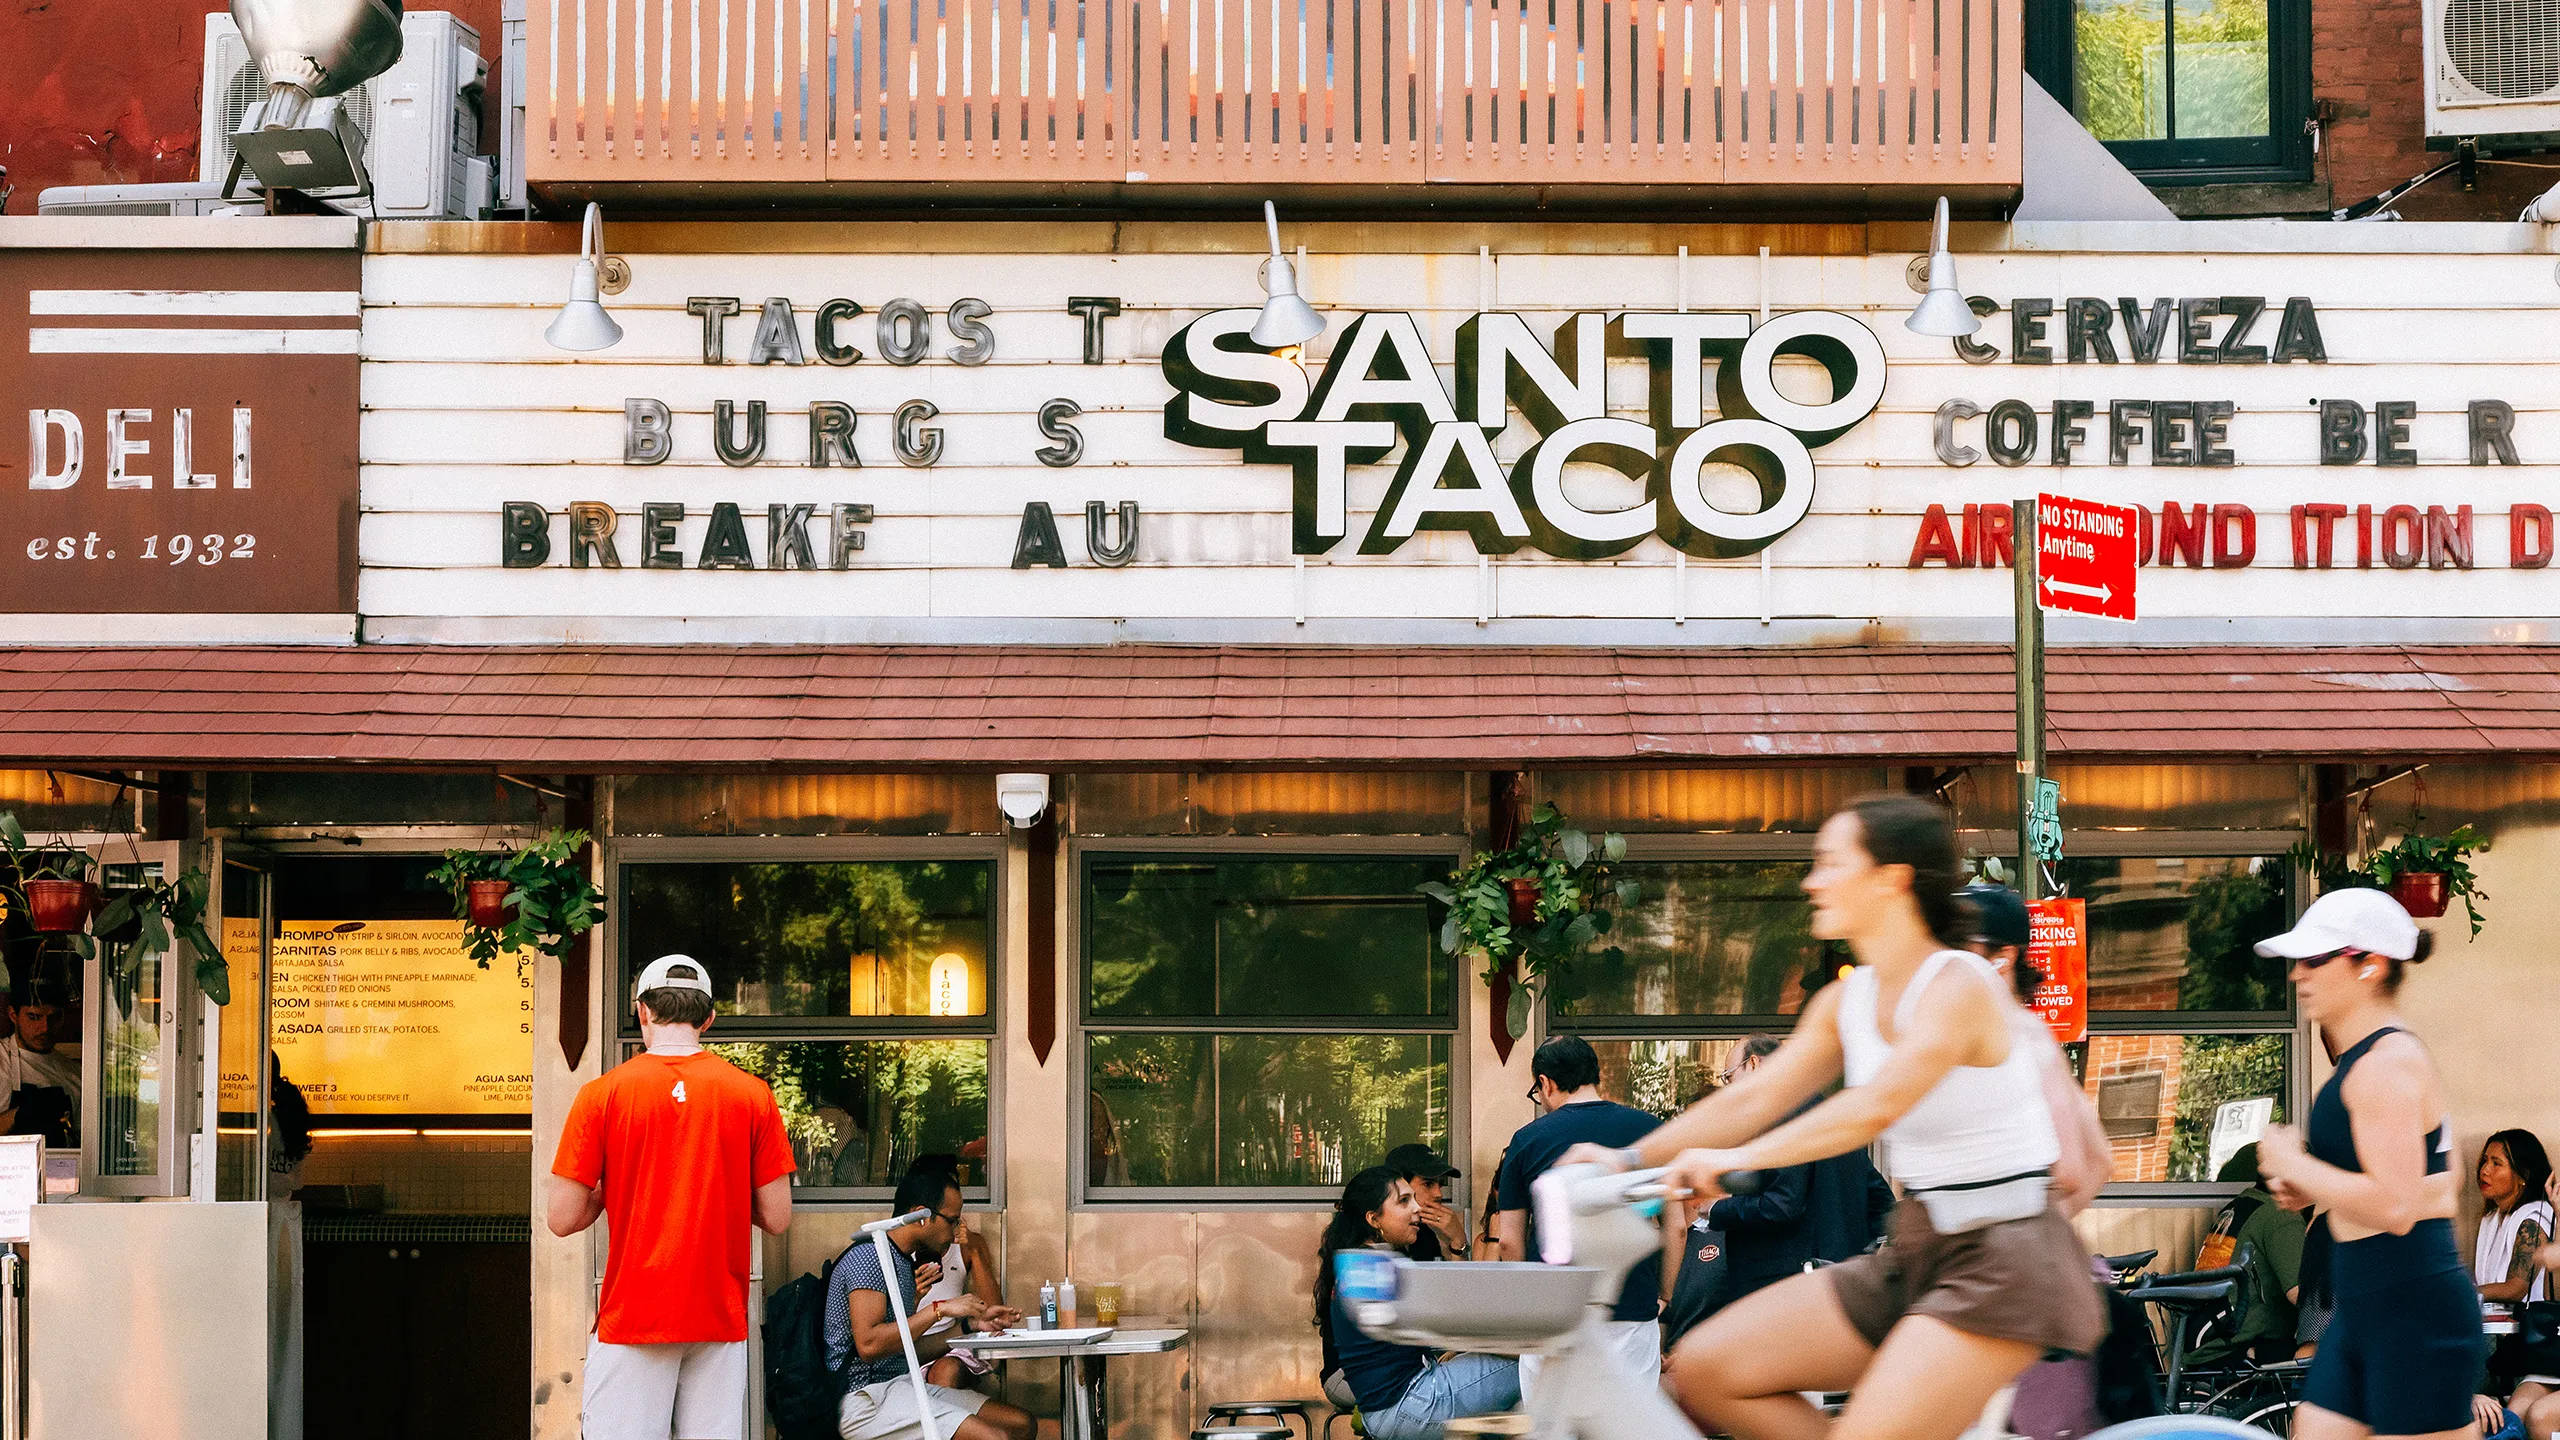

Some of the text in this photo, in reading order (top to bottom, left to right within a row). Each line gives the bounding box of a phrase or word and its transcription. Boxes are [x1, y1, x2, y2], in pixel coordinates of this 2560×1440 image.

[687, 296, 1121, 367] TACOS T
[1953, 295, 2329, 366] CERVEZA
[1184, 310, 1887, 433] SANTO
[1934, 397, 2235, 468] COFFEE
[28, 408, 252, 490] DELI
[1267, 416, 1817, 542] TACO
[2043, 504, 2124, 538] NO STANDING
[501, 500, 1139, 570] BREAKF AU
[1907, 502, 2013, 569] AIR
[2138, 502, 2257, 570] ND
[26, 531, 257, 566] est. 1932
[2043, 532, 2095, 561] Anytime
[338, 932, 349, 940] NY
[352, 932, 375, 940] STRIP
[377, 932, 383, 940] &
[421, 932, 464, 940] AVOCADO
[272, 946, 337, 956] CARNITAS
[341, 948, 363, 956] PORK
[365, 948, 389, 956] BELLY
[391, 948, 398, 956] &
[401, 948, 421, 957] RIBS,
[423, 948, 465, 956] AVOCADO
[317, 959, 345, 968] SALSA
[293, 974, 330, 982] CHICKEN
[333, 974, 358, 982] THIGH
[360, 974, 383, 982] WITH
[384, 974, 429, 982] PINEAPPLE
[432, 973, 478, 983] MARINADE,
[302, 985, 337, 993] PICKLED
[339, 985, 356, 993] RED
[358, 985, 391, 993] ONIONS
[314, 1000, 349, 1008] SHIITAKE
[352, 1000, 359, 1008] &
[361, 1000, 396, 1008] CREMINI
[398, 1000, 456, 1009] MUSHROOMS,
[2034, 996, 2073, 1007] TOWED
[272, 1010, 305, 1019] OSSOM
[278, 1024, 323, 1034] ASADA
[327, 1026, 362, 1034] GRILLED
[363, 1026, 392, 1035] STEAK,
[271, 1036, 298, 1045] SALSA
[475, 1075, 505, 1083] AGUA
[330, 1084, 338, 1093] 3
[671, 1080, 687, 1103] 4
[313, 1094, 348, 1102] BECAUSE
[349, 1094, 366, 1102] YOU
[367, 1094, 400, 1102] DESERVE
[402, 1094, 410, 1102] IT
[504, 1094, 524, 1102] PALO
[1047, 1303, 1055, 1312] S
